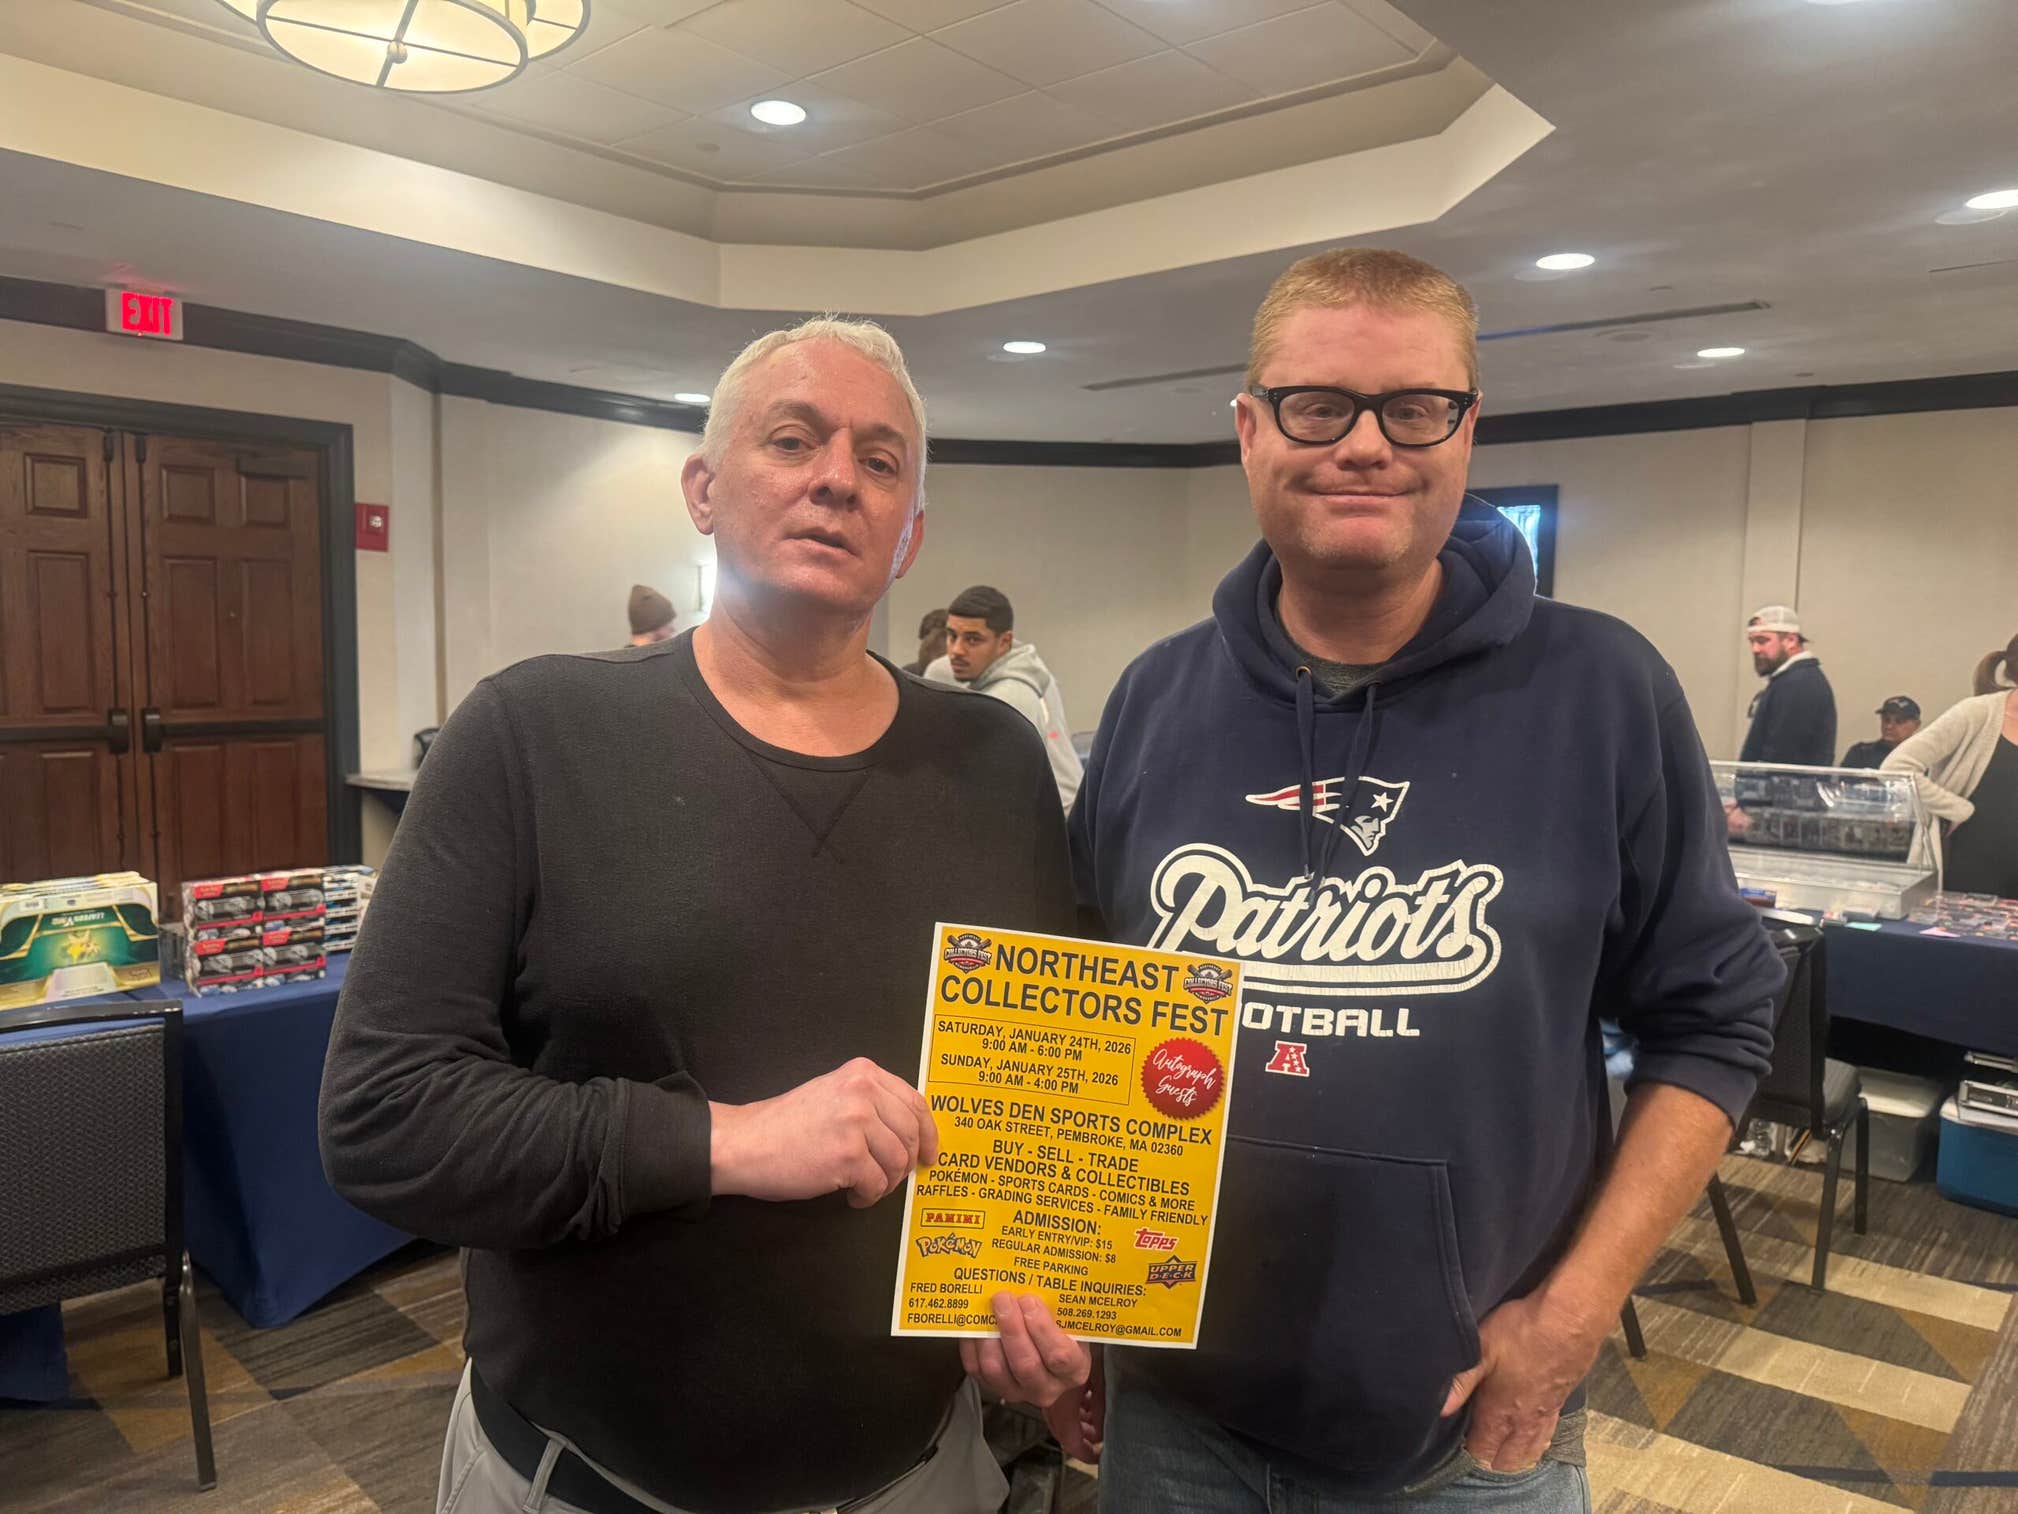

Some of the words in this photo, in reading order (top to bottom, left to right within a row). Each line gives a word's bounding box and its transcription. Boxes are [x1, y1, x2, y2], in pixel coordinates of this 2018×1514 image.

[121, 292, 173, 335] EXIT
[1152, 843, 1503, 967] Patriots
[996, 944, 1179, 993] NORTHEAST
[941, 975, 1141, 1026] COLLECTORS
[1152, 1001, 1228, 1036] FEST
[1241, 1001, 1420, 1037] OTBALL
[938, 1021, 1006, 1040] SATURDAY,
[1009, 1028, 1067, 1046] JANUARY
[1071, 1036, 1102, 1052] 24TH,
[1105, 1041, 1131, 1054] 2026
[982, 1038, 1006, 1051] 9:00
[1008, 1042, 1027, 1053] AM
[1038, 1045, 1062, 1057] 6:00
[1065, 1049, 1082, 1060] PM
[941, 1054, 993, 1071] SUNDAY,
[997, 1059, 1054, 1077] JANUARY
[1057, 1068, 1089, 1083] 25TH,
[1091, 1073, 1118, 1085] 2026
[978, 1071, 1003, 1083] 9:00
[1005, 1074, 1023, 1086] AM
[1034, 1078, 1058, 1091] 4:00
[1061, 1082, 1079, 1094] PM
[1152, 1049, 1217, 1090] Autograph
[1157, 1076, 1198, 1107] Guests
[930, 1095, 1004, 1116] WOLVES
[1009, 1102, 1045, 1121] DEN
[1050, 1108, 1121, 1133] SPORTS
[1126, 1119, 1213, 1145] COMPLEX
[954, 1117, 974, 1128] 340
[977, 1119, 1003, 1131] OAK
[1005, 1123, 1053, 1139] STREET,
[1057, 1129, 1126, 1150] PEMBROKE,
[1129, 1140, 1147, 1151] MA
[1151, 1142, 1183, 1156] 02360
[993, 1140, 1024, 1156] BUY
[1037, 1145, 1073, 1163] SELL
[1088, 1152, 1139, 1172] TRADE
[938, 1152, 980, 1169] CARD
[984, 1156, 1057, 1178] VENDORS
[1062, 1165, 1071, 1180] &
[1076, 1167, 1190, 1195] COLLECTIBLES
[929, 1168, 988, 1184] POKÉMON
[998, 1174, 1045, 1192] SPORTS
[1048, 1182, 1089, 1198] CARDS
[1099, 1189, 1146, 1206] COMICS
[1149, 1195, 1157, 1207] &
[1160, 1197, 1195, 1211] MORE
[917, 1185, 968, 1197] RAFFLES
[978, 1188, 1032, 1204] GRADING
[1036, 1195, 1094, 1213] SERVICES
[1104, 1205, 1147, 1221] FAMILY
[1150, 1210, 1208, 1226] FRIENDLY
[926, 1212, 980, 1224] PANINI
[1001, 1226, 1035, 1238] EARLY
[1038, 1231, 1093, 1248] ENTRY/VIP:
[1095, 1239, 1112, 1249] $15
[1013, 1210, 1101, 1236] ADMISSION:
[992, 1239, 1041, 1254] REGULAR
[1044, 1246, 1103, 1262] ADMISSION:
[1105, 1253, 1116, 1264] $8
[1014, 1257, 1040, 1270] FREE
[1043, 1261, 1089, 1276] PARKING
[954, 1267, 1026, 1285] QUESTIONS
[1036, 1275, 1078, 1291] TABLE
[1081, 1280, 1146, 1297] INQUIRIES:
[1150, 1264, 1195, 1273] UPPER
[909, 1298, 969, 1308] 617.462.8899
[910, 1283, 936, 1293] FRED
[940, 1283, 983, 1294] BORELLI
[1059, 1294, 1086, 1304] SEAN
[1089, 1296, 1138, 1307] MCELROY
[907, 1313, 998, 1326] FBORELLI@COMC
[1056, 1320, 1182, 1336] SJMCELROY@GMAIL.COM
[1057, 1307, 1117, 1319] 508.269.1293
